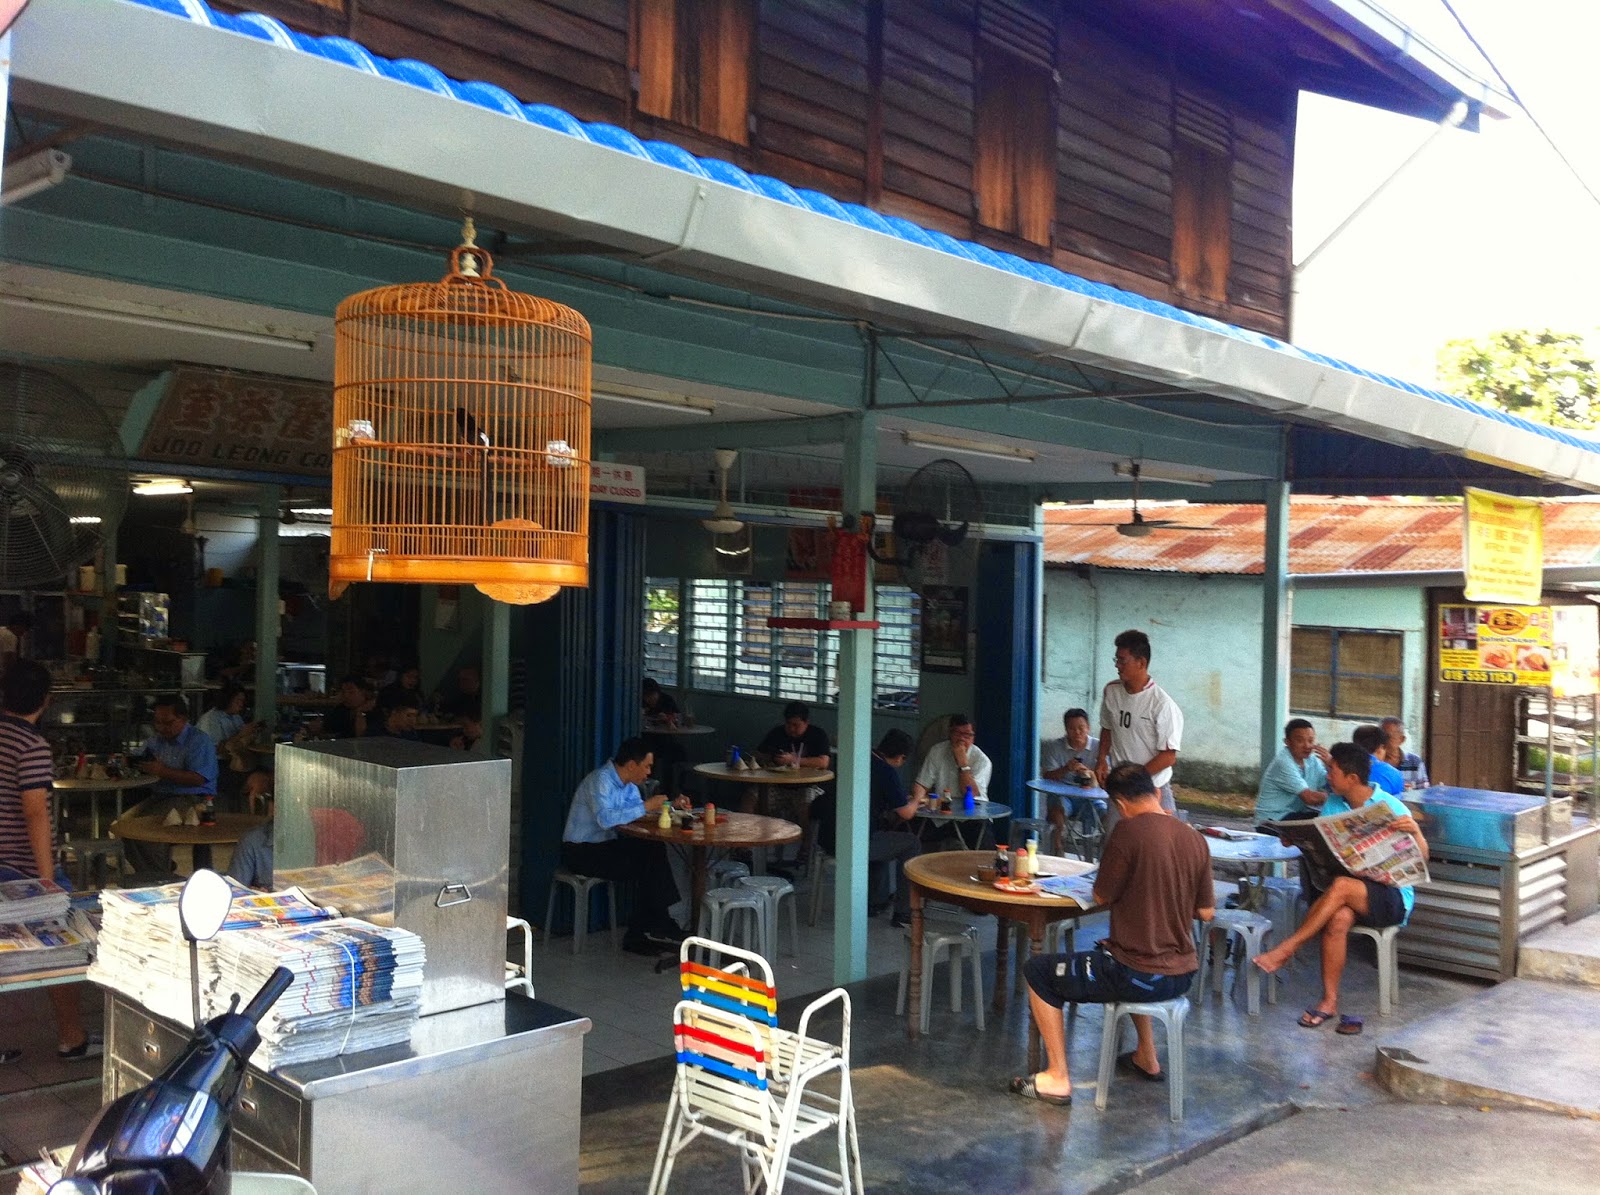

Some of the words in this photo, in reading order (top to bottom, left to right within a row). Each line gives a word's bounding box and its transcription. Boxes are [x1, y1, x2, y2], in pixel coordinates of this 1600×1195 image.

[151, 438, 203, 456] JOO
[212, 443, 291, 464] LEONG
[300, 452, 332, 467] CA
[609, 486, 641, 498] CLOSED
[1119, 709, 1132, 729] 10
